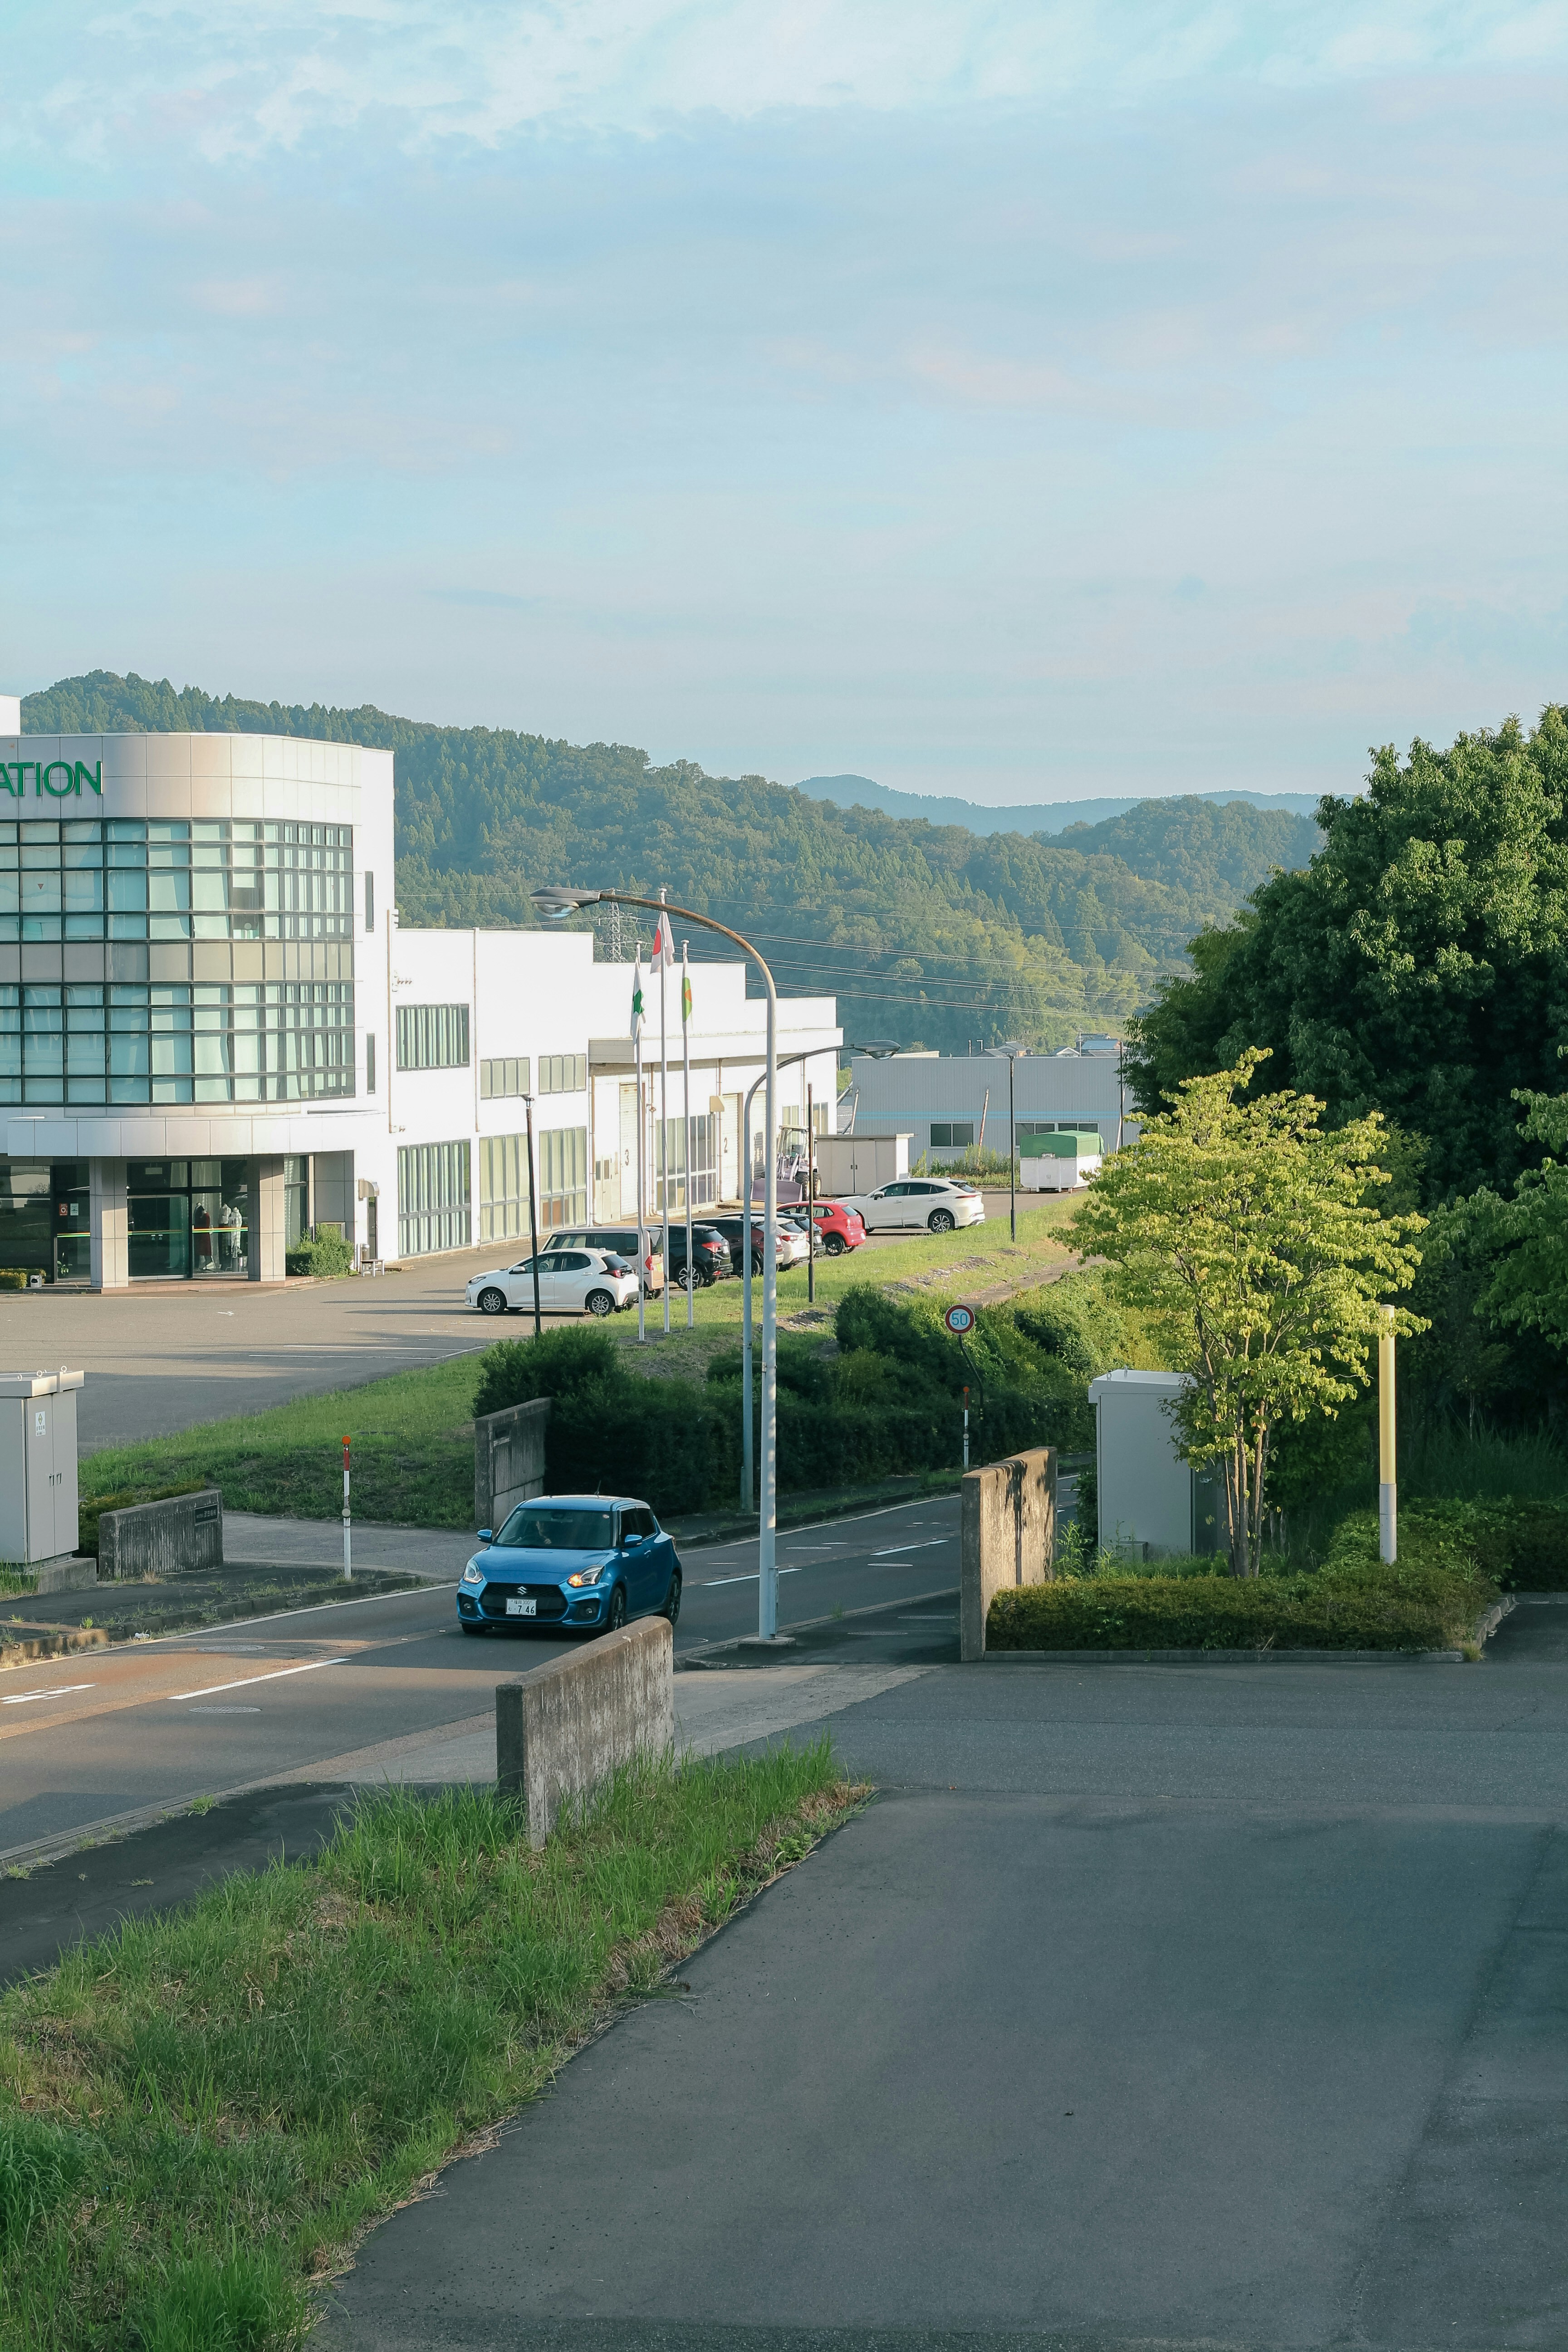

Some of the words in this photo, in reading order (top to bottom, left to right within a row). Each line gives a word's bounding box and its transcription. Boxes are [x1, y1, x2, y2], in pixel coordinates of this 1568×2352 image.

[724, 1137, 728, 1153] 2
[625, 1149, 629, 1166] 3
[952, 1313, 967, 1325] 50
